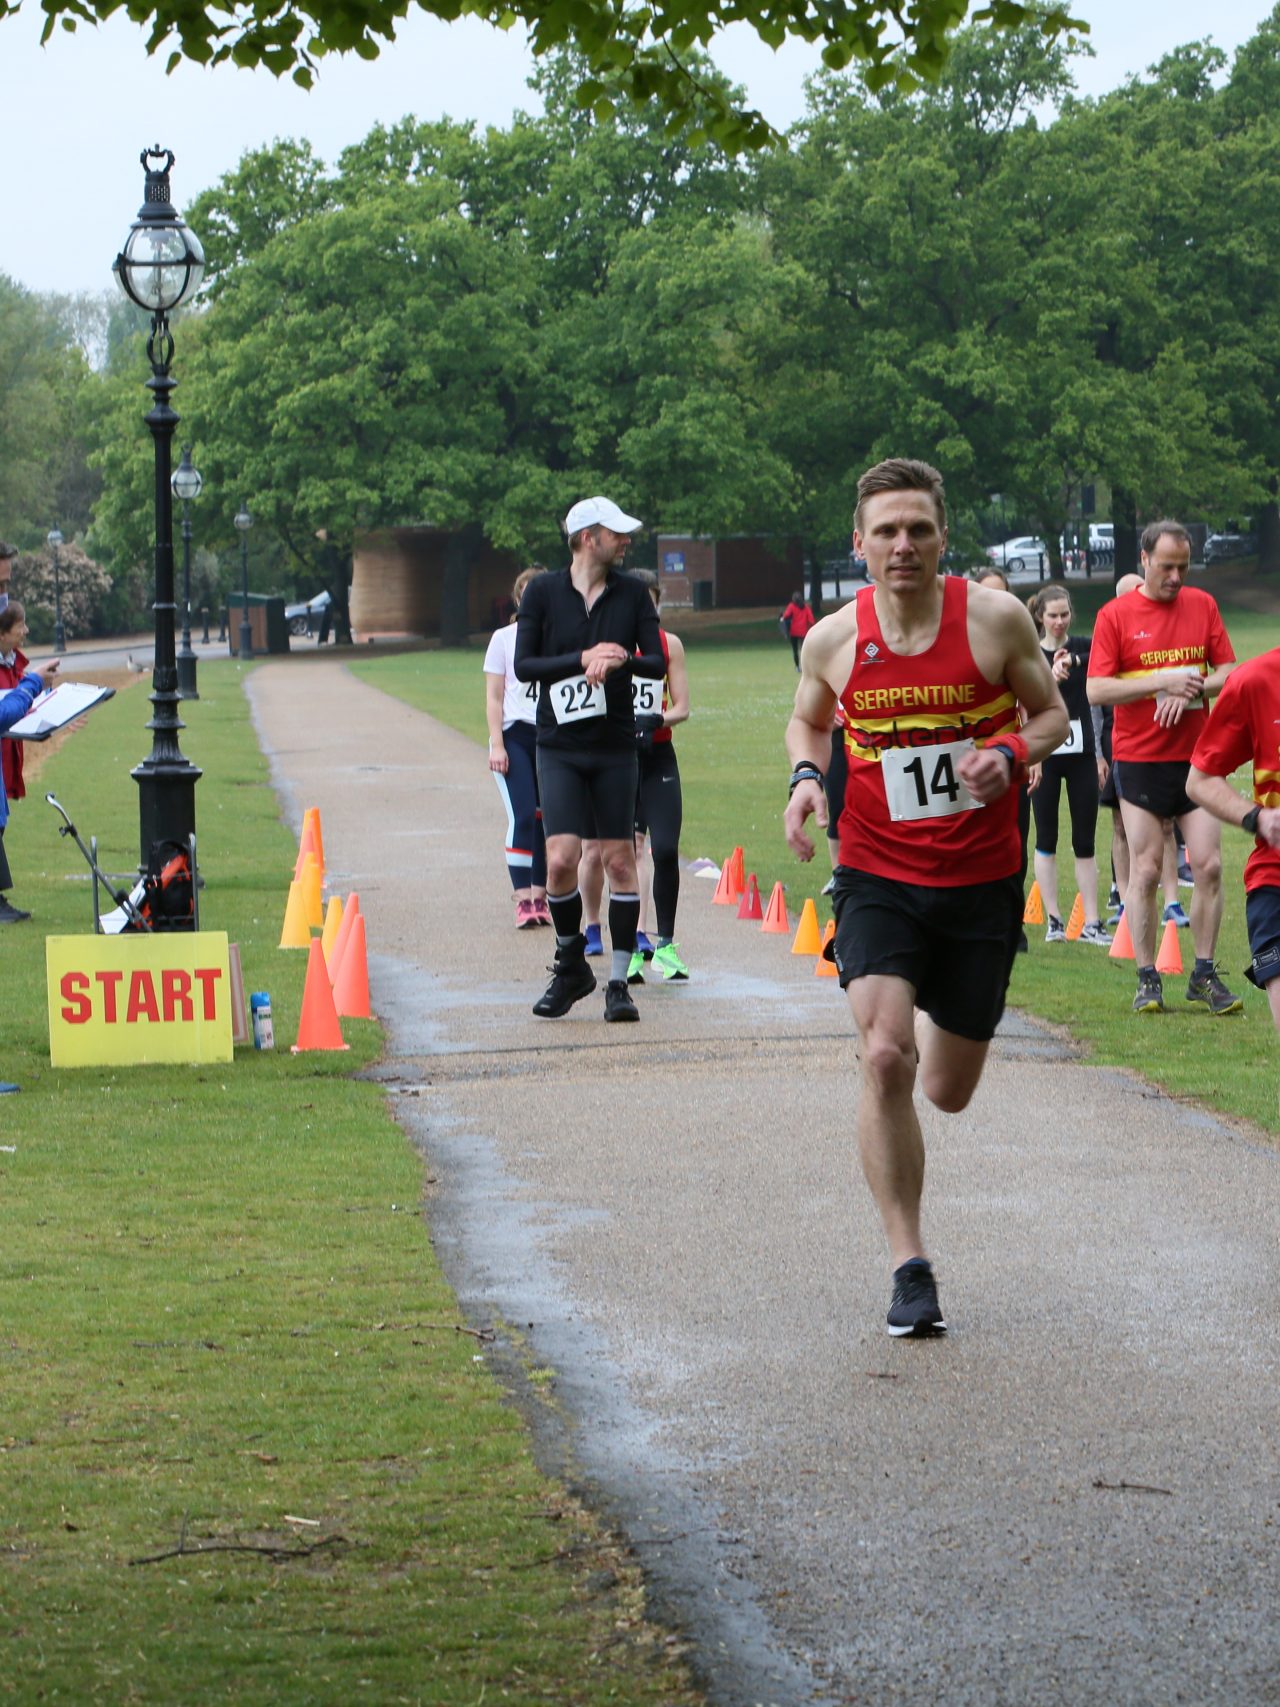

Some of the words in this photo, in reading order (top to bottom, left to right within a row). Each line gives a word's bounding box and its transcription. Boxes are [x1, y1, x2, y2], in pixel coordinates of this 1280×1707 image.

[560, 681, 596, 714] 22
[853, 684, 976, 711] SERPENTINE
[903, 753, 960, 807] 14
[60, 968, 222, 1024] START
